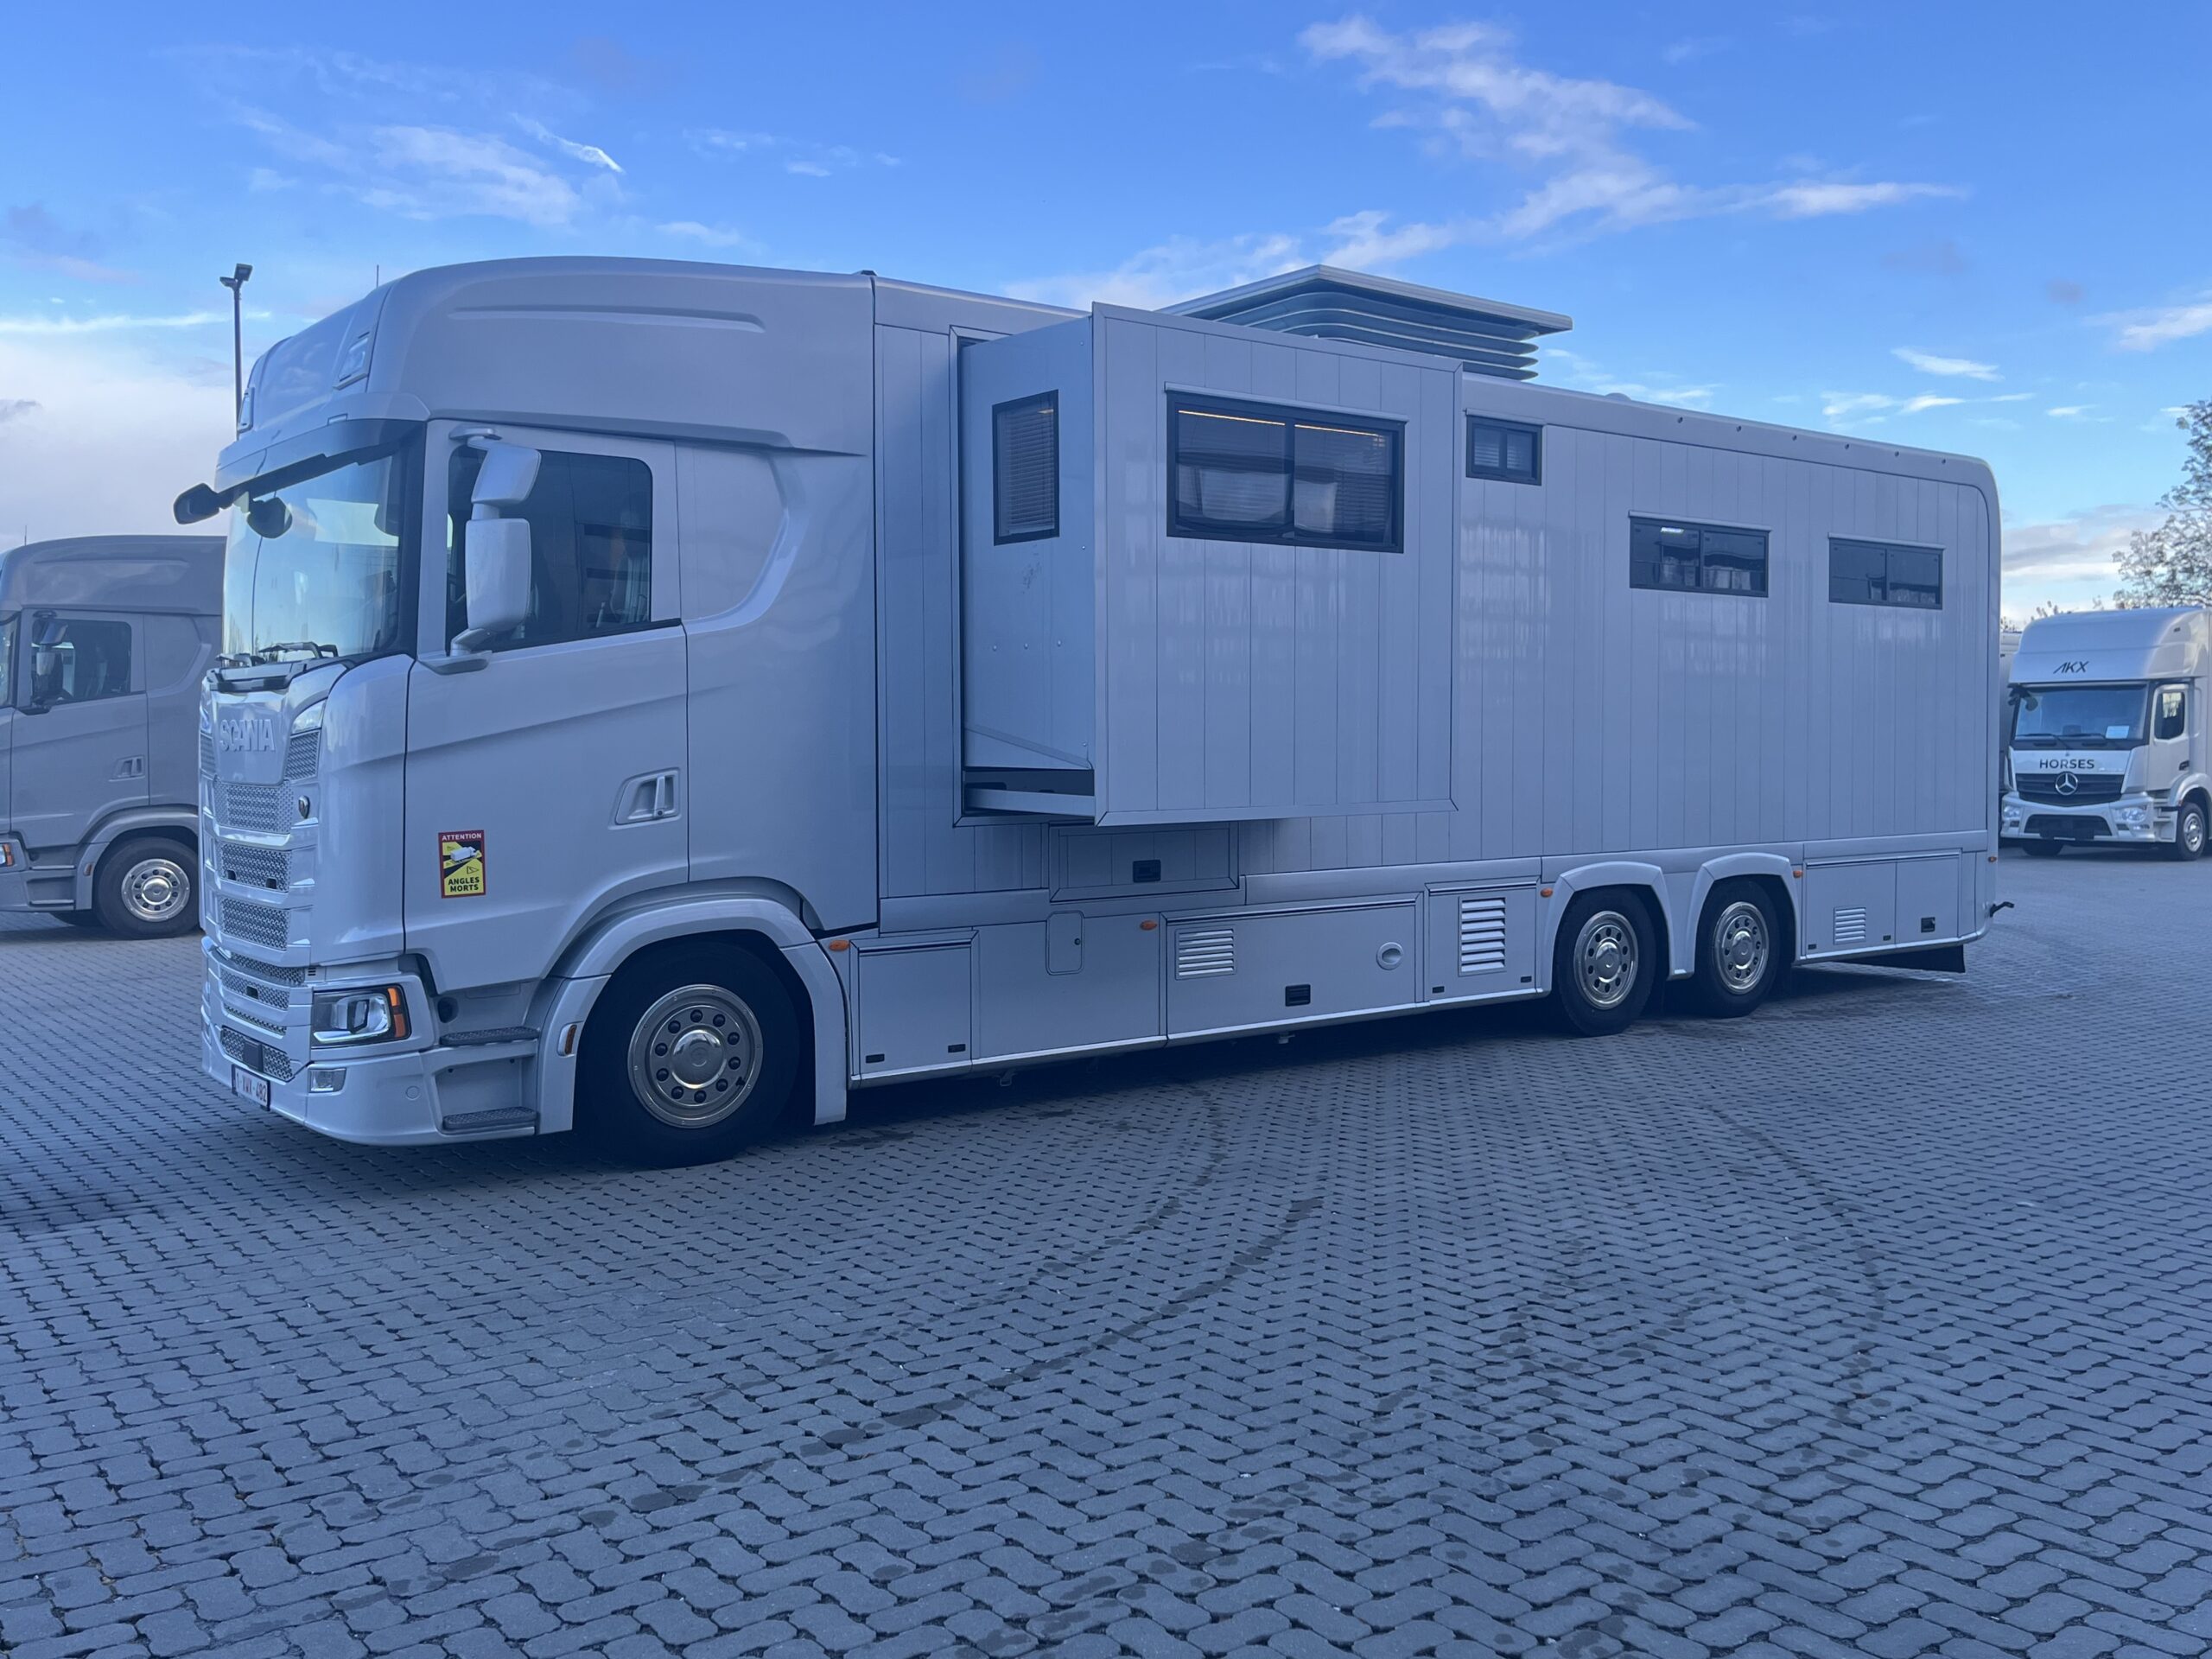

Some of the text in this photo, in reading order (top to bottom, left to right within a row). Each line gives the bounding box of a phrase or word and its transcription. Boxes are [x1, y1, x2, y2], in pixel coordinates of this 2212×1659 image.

[2053, 661, 2089, 674] AKX
[220, 719, 276, 752] SCANIA
[2039, 759, 2094, 769] HORSES
[442, 832, 482, 841] ATTENTION
[449, 883, 479, 892] MORTS
